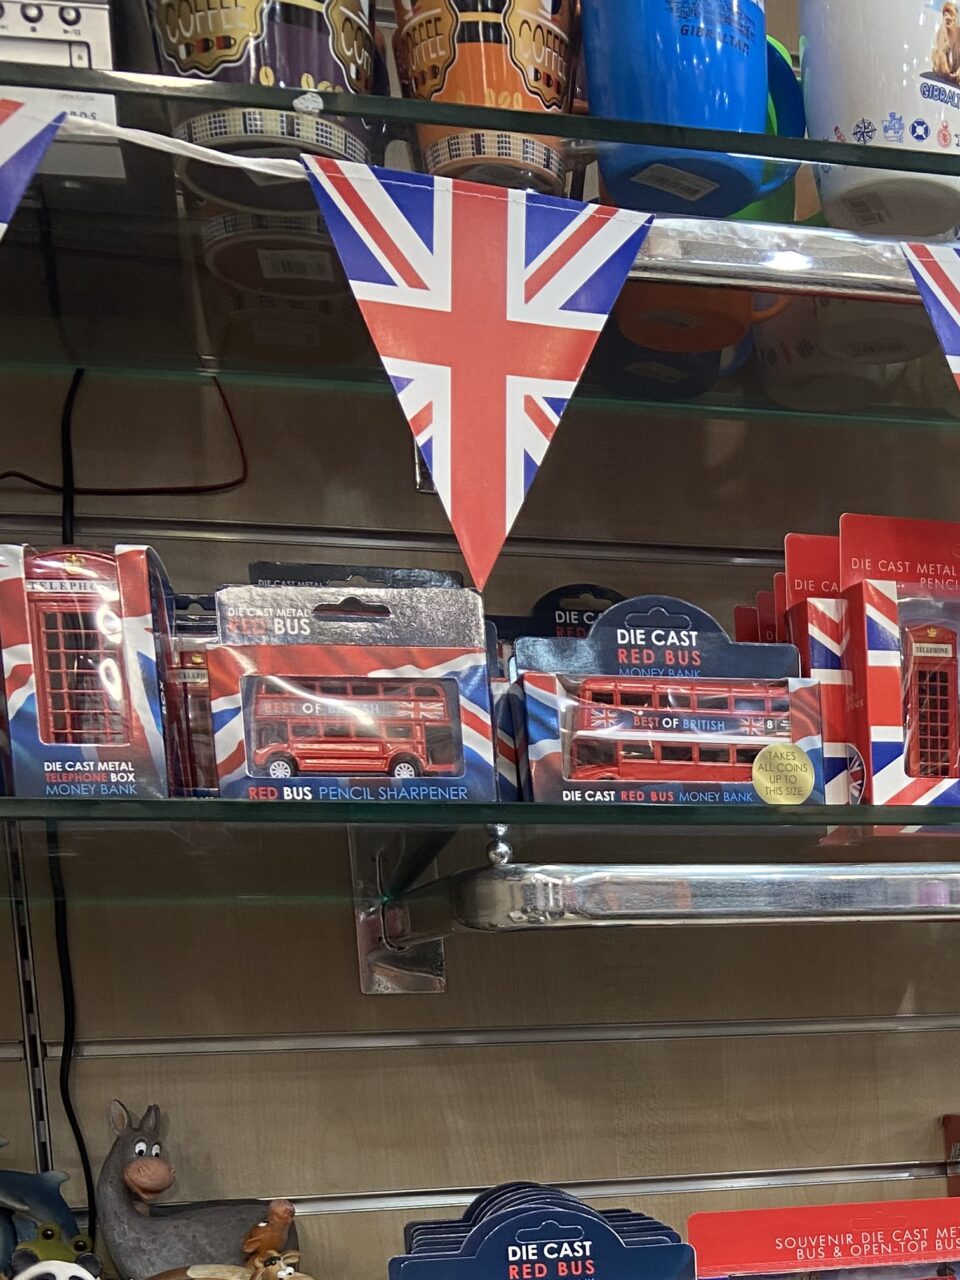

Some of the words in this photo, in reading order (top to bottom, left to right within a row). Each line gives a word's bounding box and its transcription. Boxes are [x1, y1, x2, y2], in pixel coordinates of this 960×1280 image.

[680, 24, 750, 56] GIBRALTAR
[851, 558, 873, 569] DIE
[878, 560, 911, 573] CAST
[917, 563, 957, 577] METAL
[794, 579, 815, 590] DIE
[227, 607, 246, 616] DIE
[250, 607, 274, 617] CAST
[277, 608, 308, 618] METAL
[555, 611, 578, 623] DIE
[273, 618, 311, 635] BUS
[617, 630, 647, 645] DIE
[651, 630, 698, 646] CAST
[618, 650, 656, 665] RED
[666, 650, 702, 665] BUS
[619, 668, 666, 677] MONEY
[668, 668, 702, 678] BANK
[302, 703, 320, 714] OF
[633, 716, 660, 728] BEST
[662, 717, 679, 729] OF
[682, 718, 725, 730] BRITISH
[766, 720, 773, 730] 8
[767, 752, 796, 761] TAKES
[44, 762, 62, 771] DIE
[65, 762, 94, 771] CAST
[99, 762, 135, 771] METAL
[757, 763, 774, 773] ALL
[777, 763, 808, 773] COINS
[45, 773, 107, 782] TELEPHONE
[110, 773, 136, 782] BOX
[769, 775, 782, 785] UP
[785, 775, 797, 784] TO
[46, 784, 96, 795] MONEY
[100, 784, 137, 795] BANK
[248, 787, 278, 800] RED
[283, 787, 312, 800] BUS
[319, 787, 372, 800] PENCIL
[379, 787, 468, 800] SHARPENER
[765, 787, 782, 796] THIS
[785, 786, 803, 796] SIZE
[562, 791, 582, 801] DIE
[585, 791, 615, 801] CAST
[620, 792, 645, 801] RED
[651, 792, 674, 801] BUS
[679, 792, 720, 801] MONEY
[723, 792, 753, 801] BANK
[775, 1234, 853, 1250] SOUVENIR
[862, 1231, 884, 1243] DIE
[892, 1229, 928, 1242] CAST
[508, 1246, 538, 1261] DIE
[543, 1241, 592, 1258] CAST
[797, 1248, 825, 1260] BUS
[834, 1247, 842, 1257] &
[851, 1241, 928, 1256] OPEN-TOP
[508, 1264, 547, 1279] RED
[557, 1260, 596, 1277] BUS
